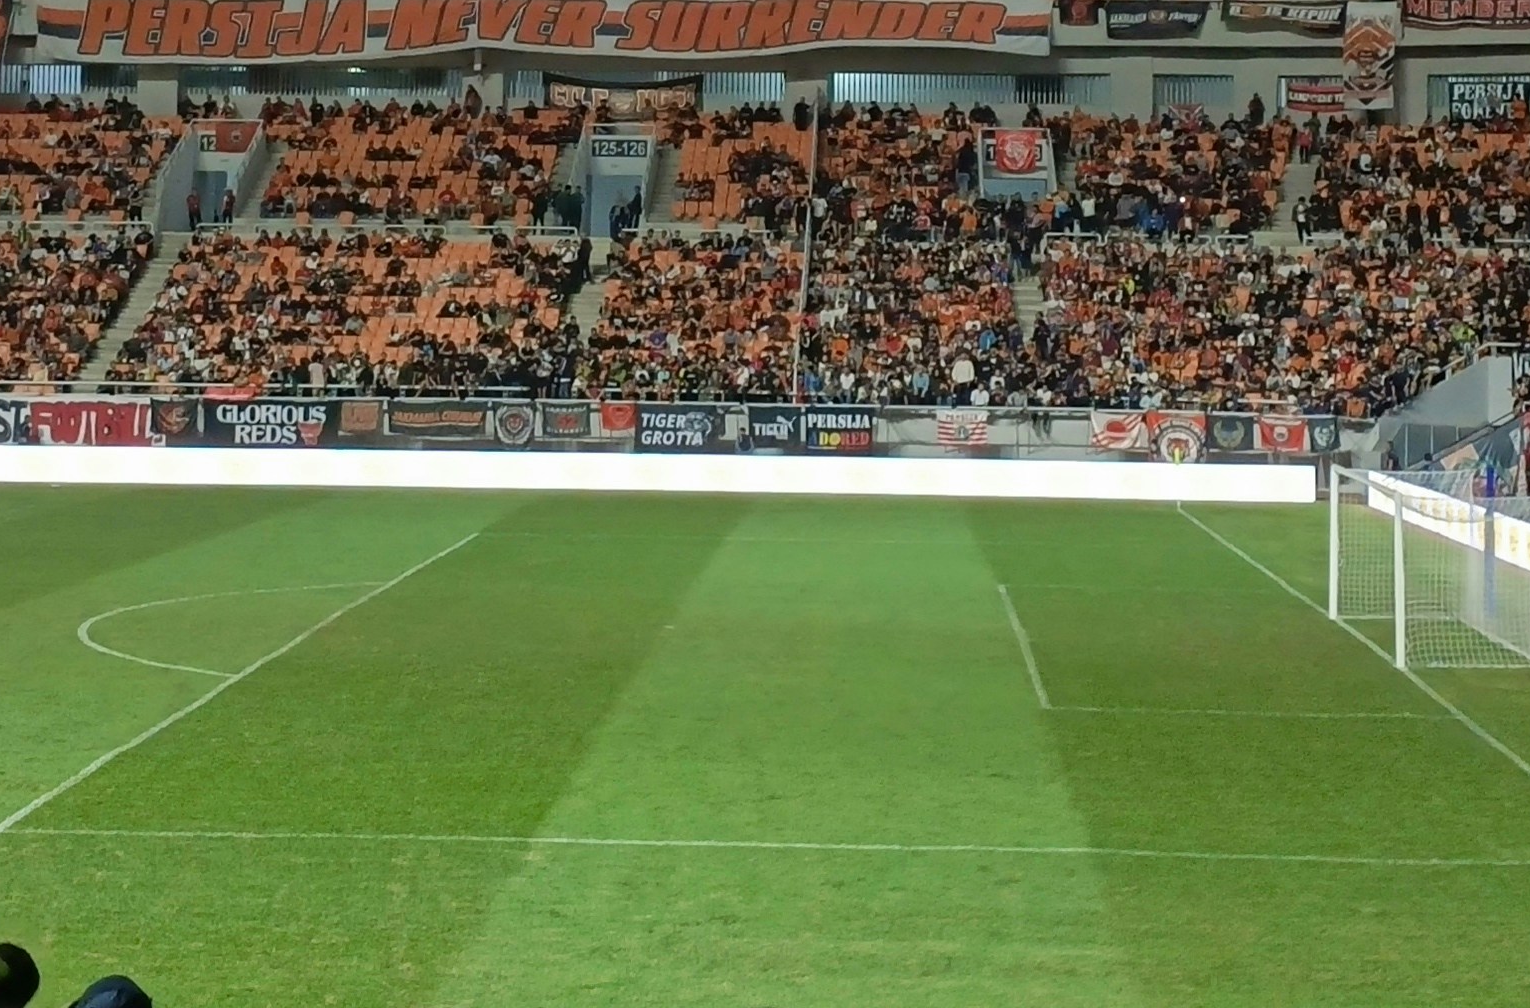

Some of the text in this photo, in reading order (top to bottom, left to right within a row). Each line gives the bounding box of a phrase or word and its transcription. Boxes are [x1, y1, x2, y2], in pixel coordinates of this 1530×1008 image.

[1452, 83, 1525, 101] PERSIJA
[593, 140, 646, 156] 125-126
[215, 403, 327, 425] GLORIOUS
[640, 412, 686, 429] TIGER
[807, 413, 872, 430] PERSIJA
[233, 424, 298, 446] REDS
[640, 430, 704, 446] GROTTA
[808, 430, 871, 447] ADORED
